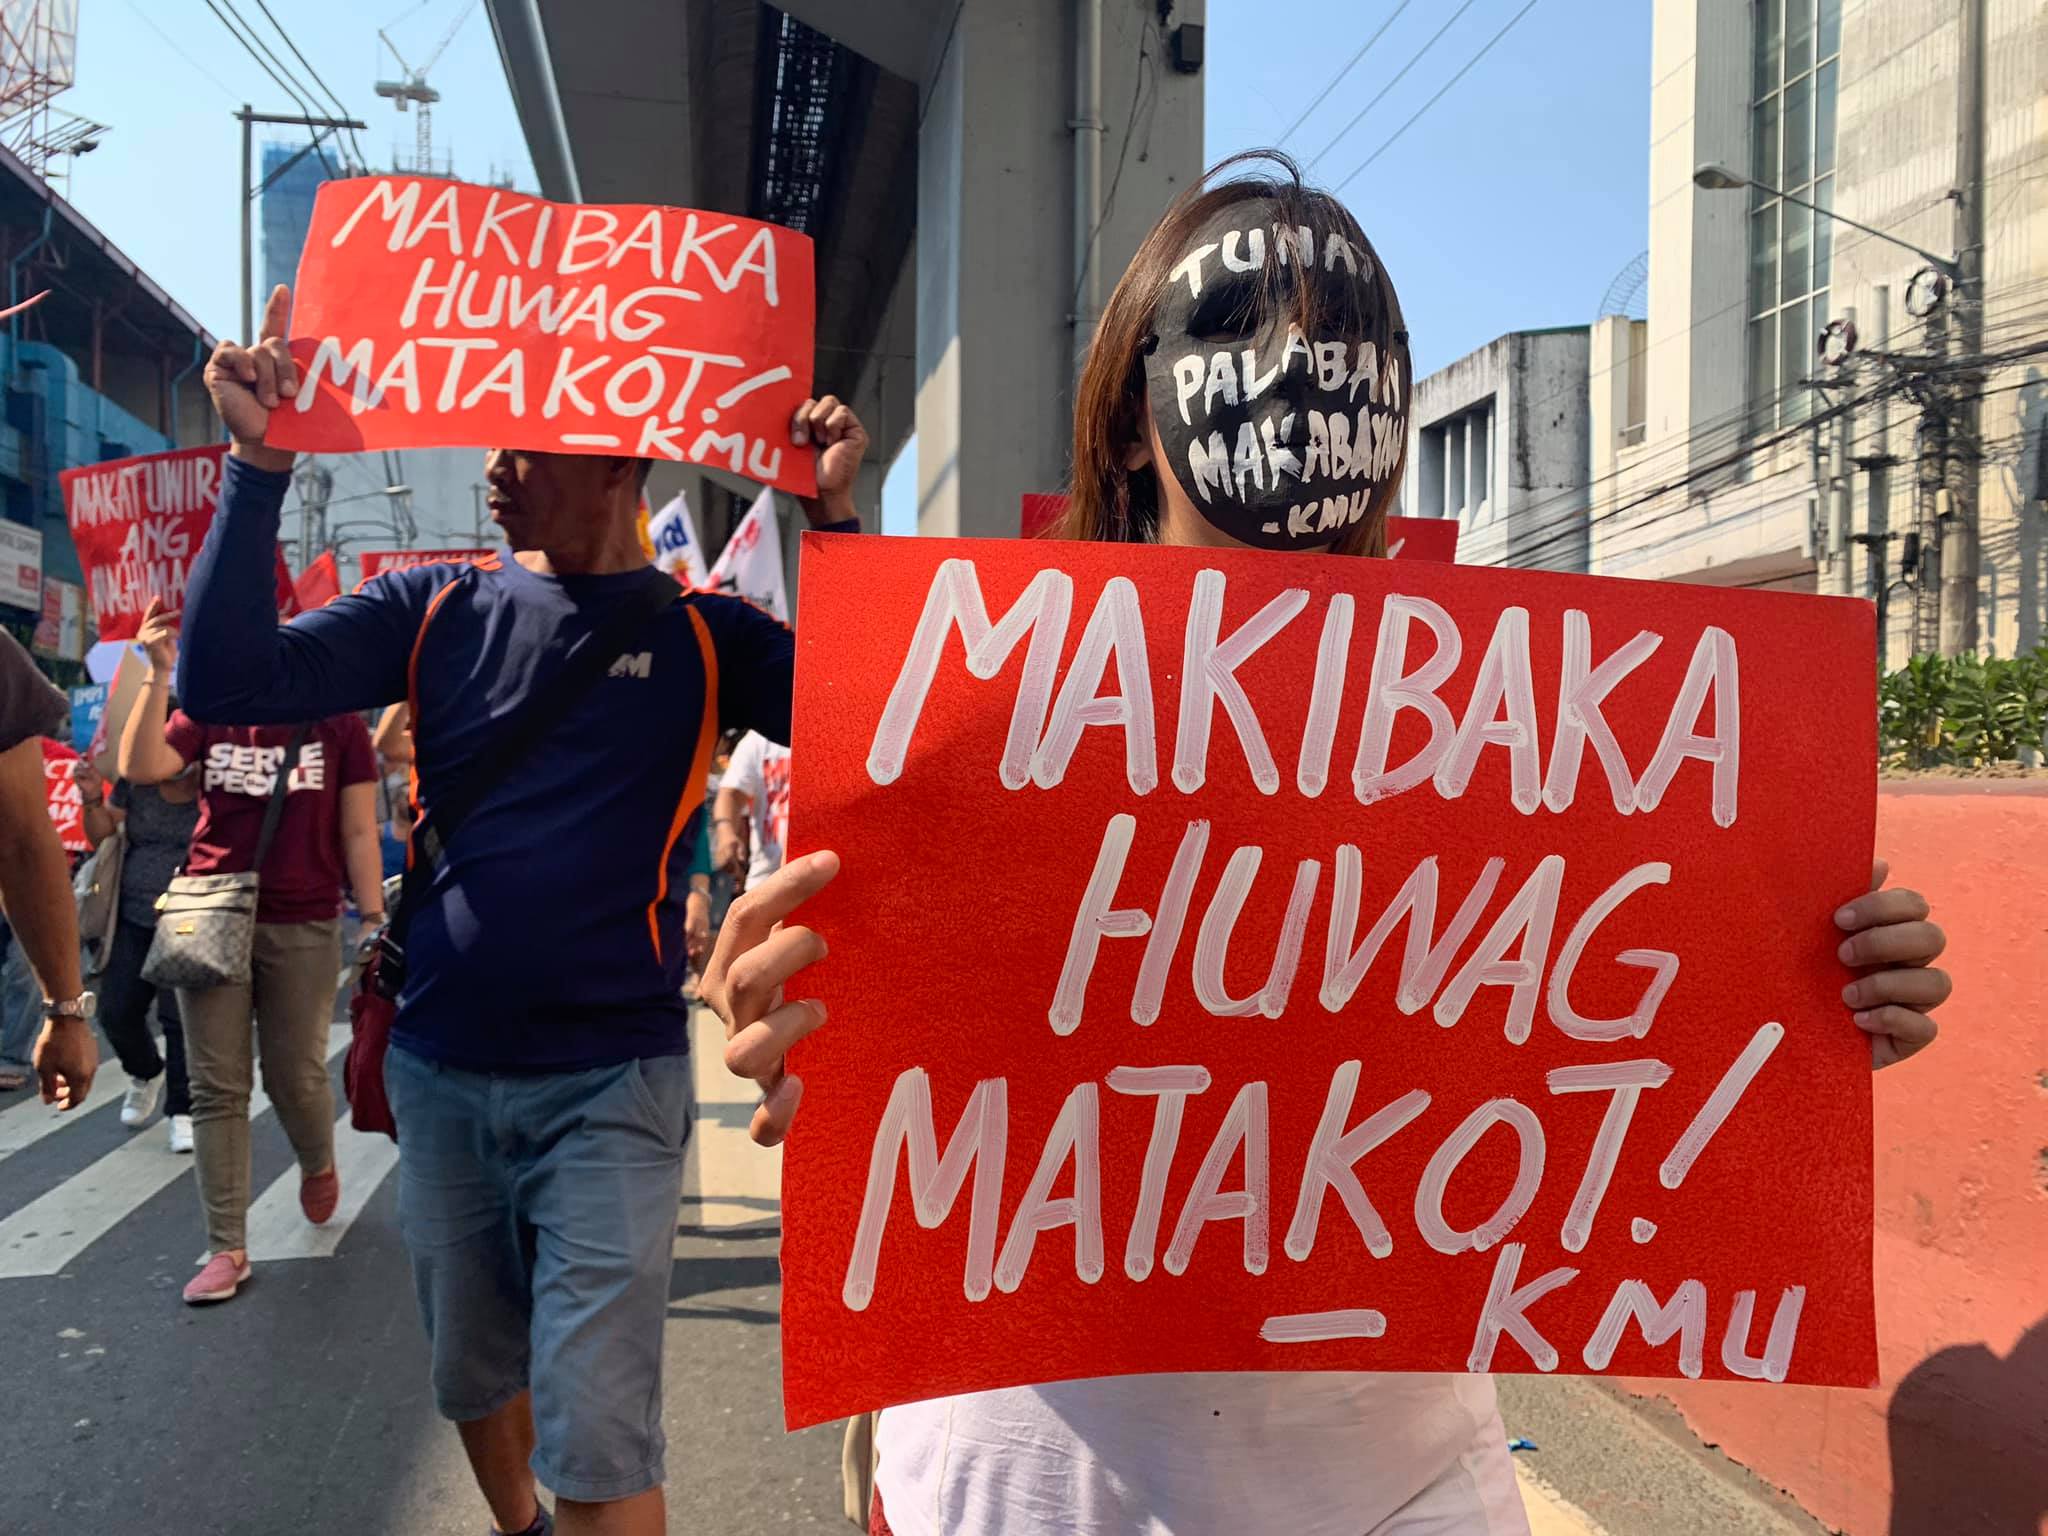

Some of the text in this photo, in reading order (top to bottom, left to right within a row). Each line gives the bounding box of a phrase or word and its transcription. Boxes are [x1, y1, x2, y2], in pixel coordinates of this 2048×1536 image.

[331, 180, 778, 306] MAKIBAKA
[400, 258, 702, 342] HUWAG
[295, 336, 792, 424] MATAKOT!
[1173, 322, 1400, 425] PALABAN
[638, 416, 781, 479] KMU
[119, 516, 189, 565] ANG
[866, 558, 1740, 827] MAKIBAKA
[1048, 813, 1679, 1044] HUWAG
[843, 1022, 1784, 1311] MATAKOT!
[1468, 1243, 1806, 1383] KMU
